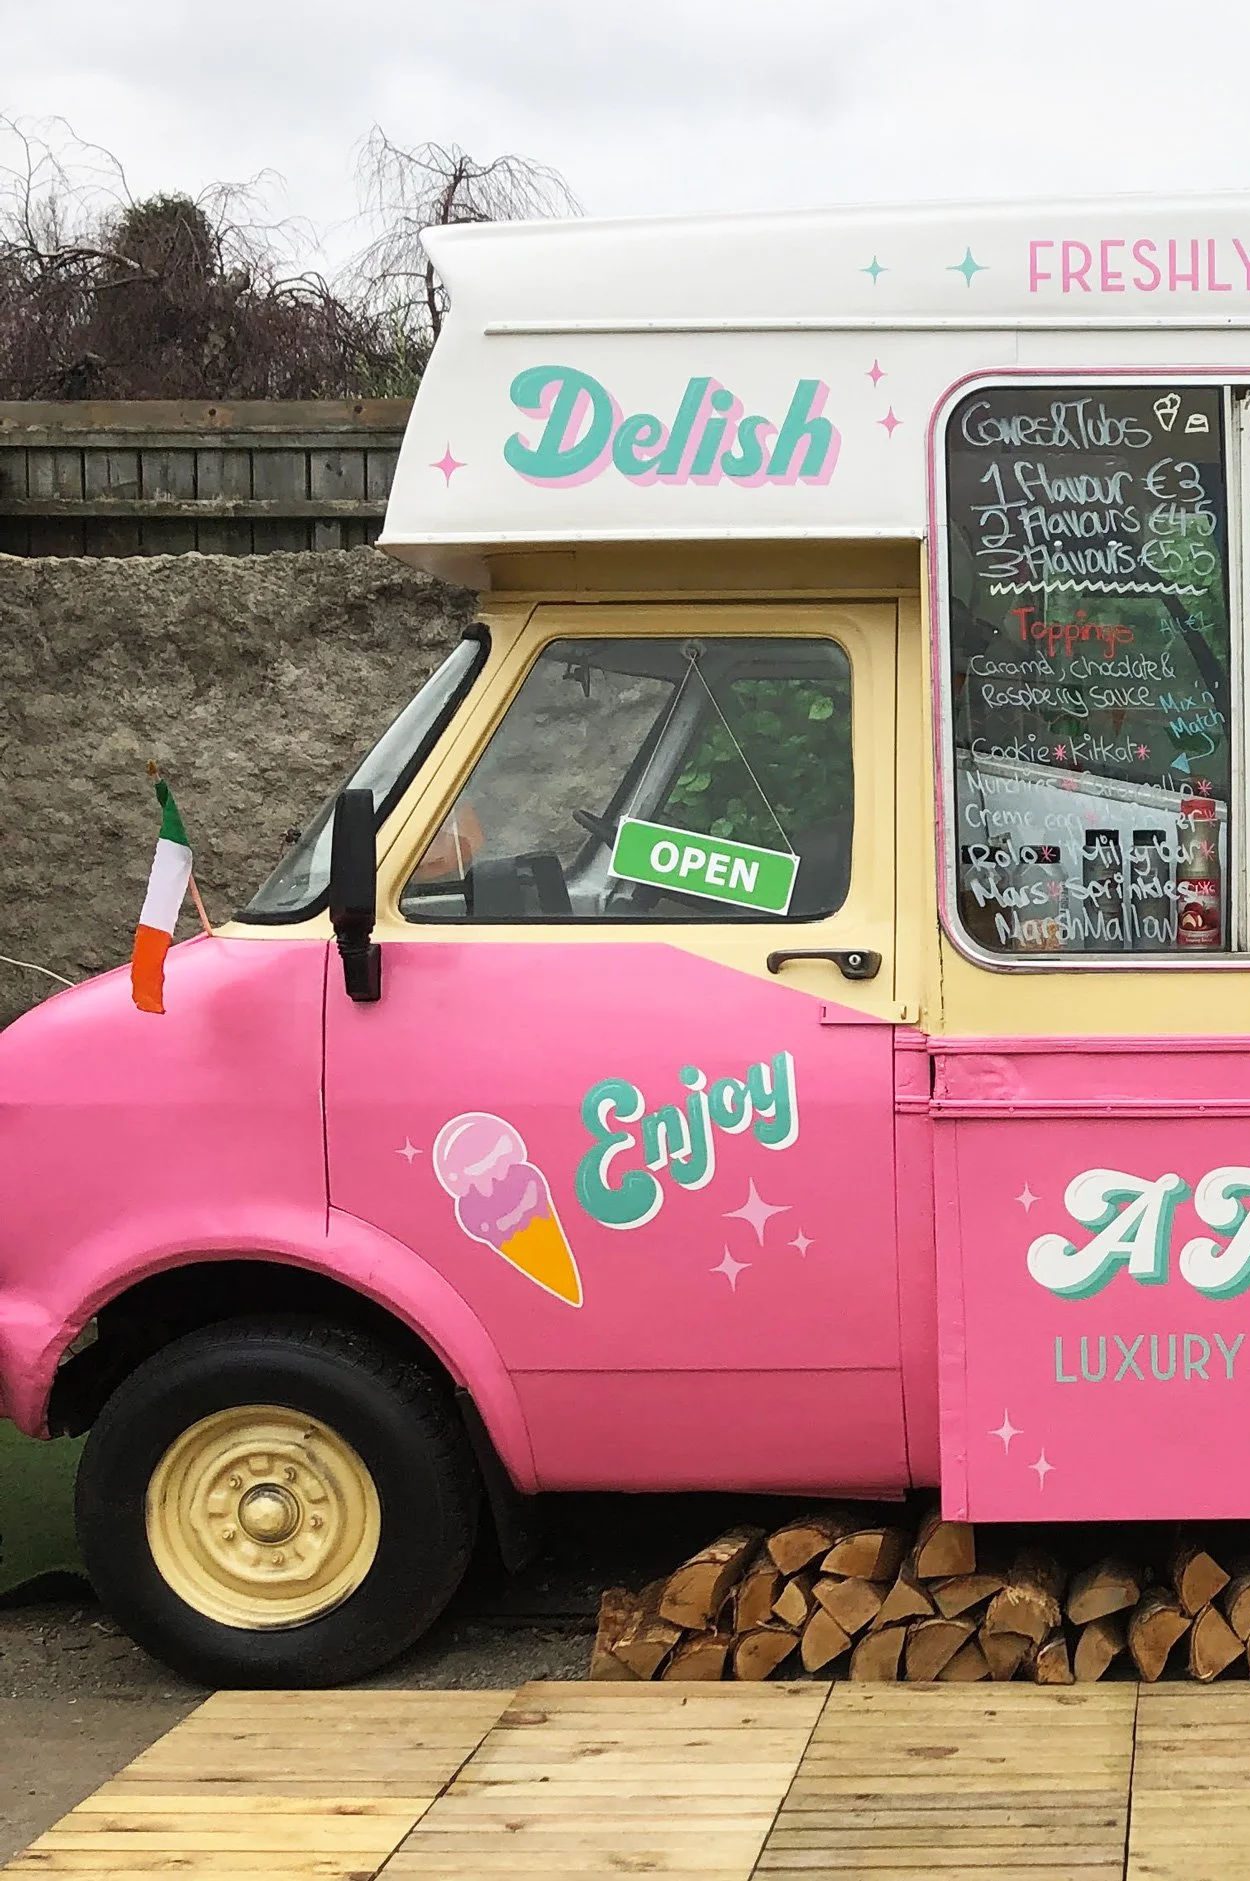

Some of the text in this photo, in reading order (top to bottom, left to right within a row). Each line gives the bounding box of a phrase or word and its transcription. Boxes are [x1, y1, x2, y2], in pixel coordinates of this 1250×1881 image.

[503, 364, 842, 489] Delish
[1013, 461, 1134, 506] Flavour
[1140, 457, 1205, 502] €3
[979, 510, 1016, 548] 2
[1018, 504, 1141, 547] Flavours
[975, 547, 1024, 578] 3
[1020, 542, 1137, 579] Flavours
[1010, 605, 1135, 659] Toppings
[981, 682, 1090, 718] Raspberry
[1159, 694, 1197, 714] Mix
[1169, 711, 1226, 739] Match
[971, 733, 1051, 763] Cookie
[650, 840, 760, 893] OPEN
[967, 843, 1040, 870] Rolo
[969, 876, 1050, 909] Mars
[574, 1049, 800, 1231] Enjoy
[1026, 1166, 1188, 1298] A
[1053, 1332, 1246, 1384] LUXURY
